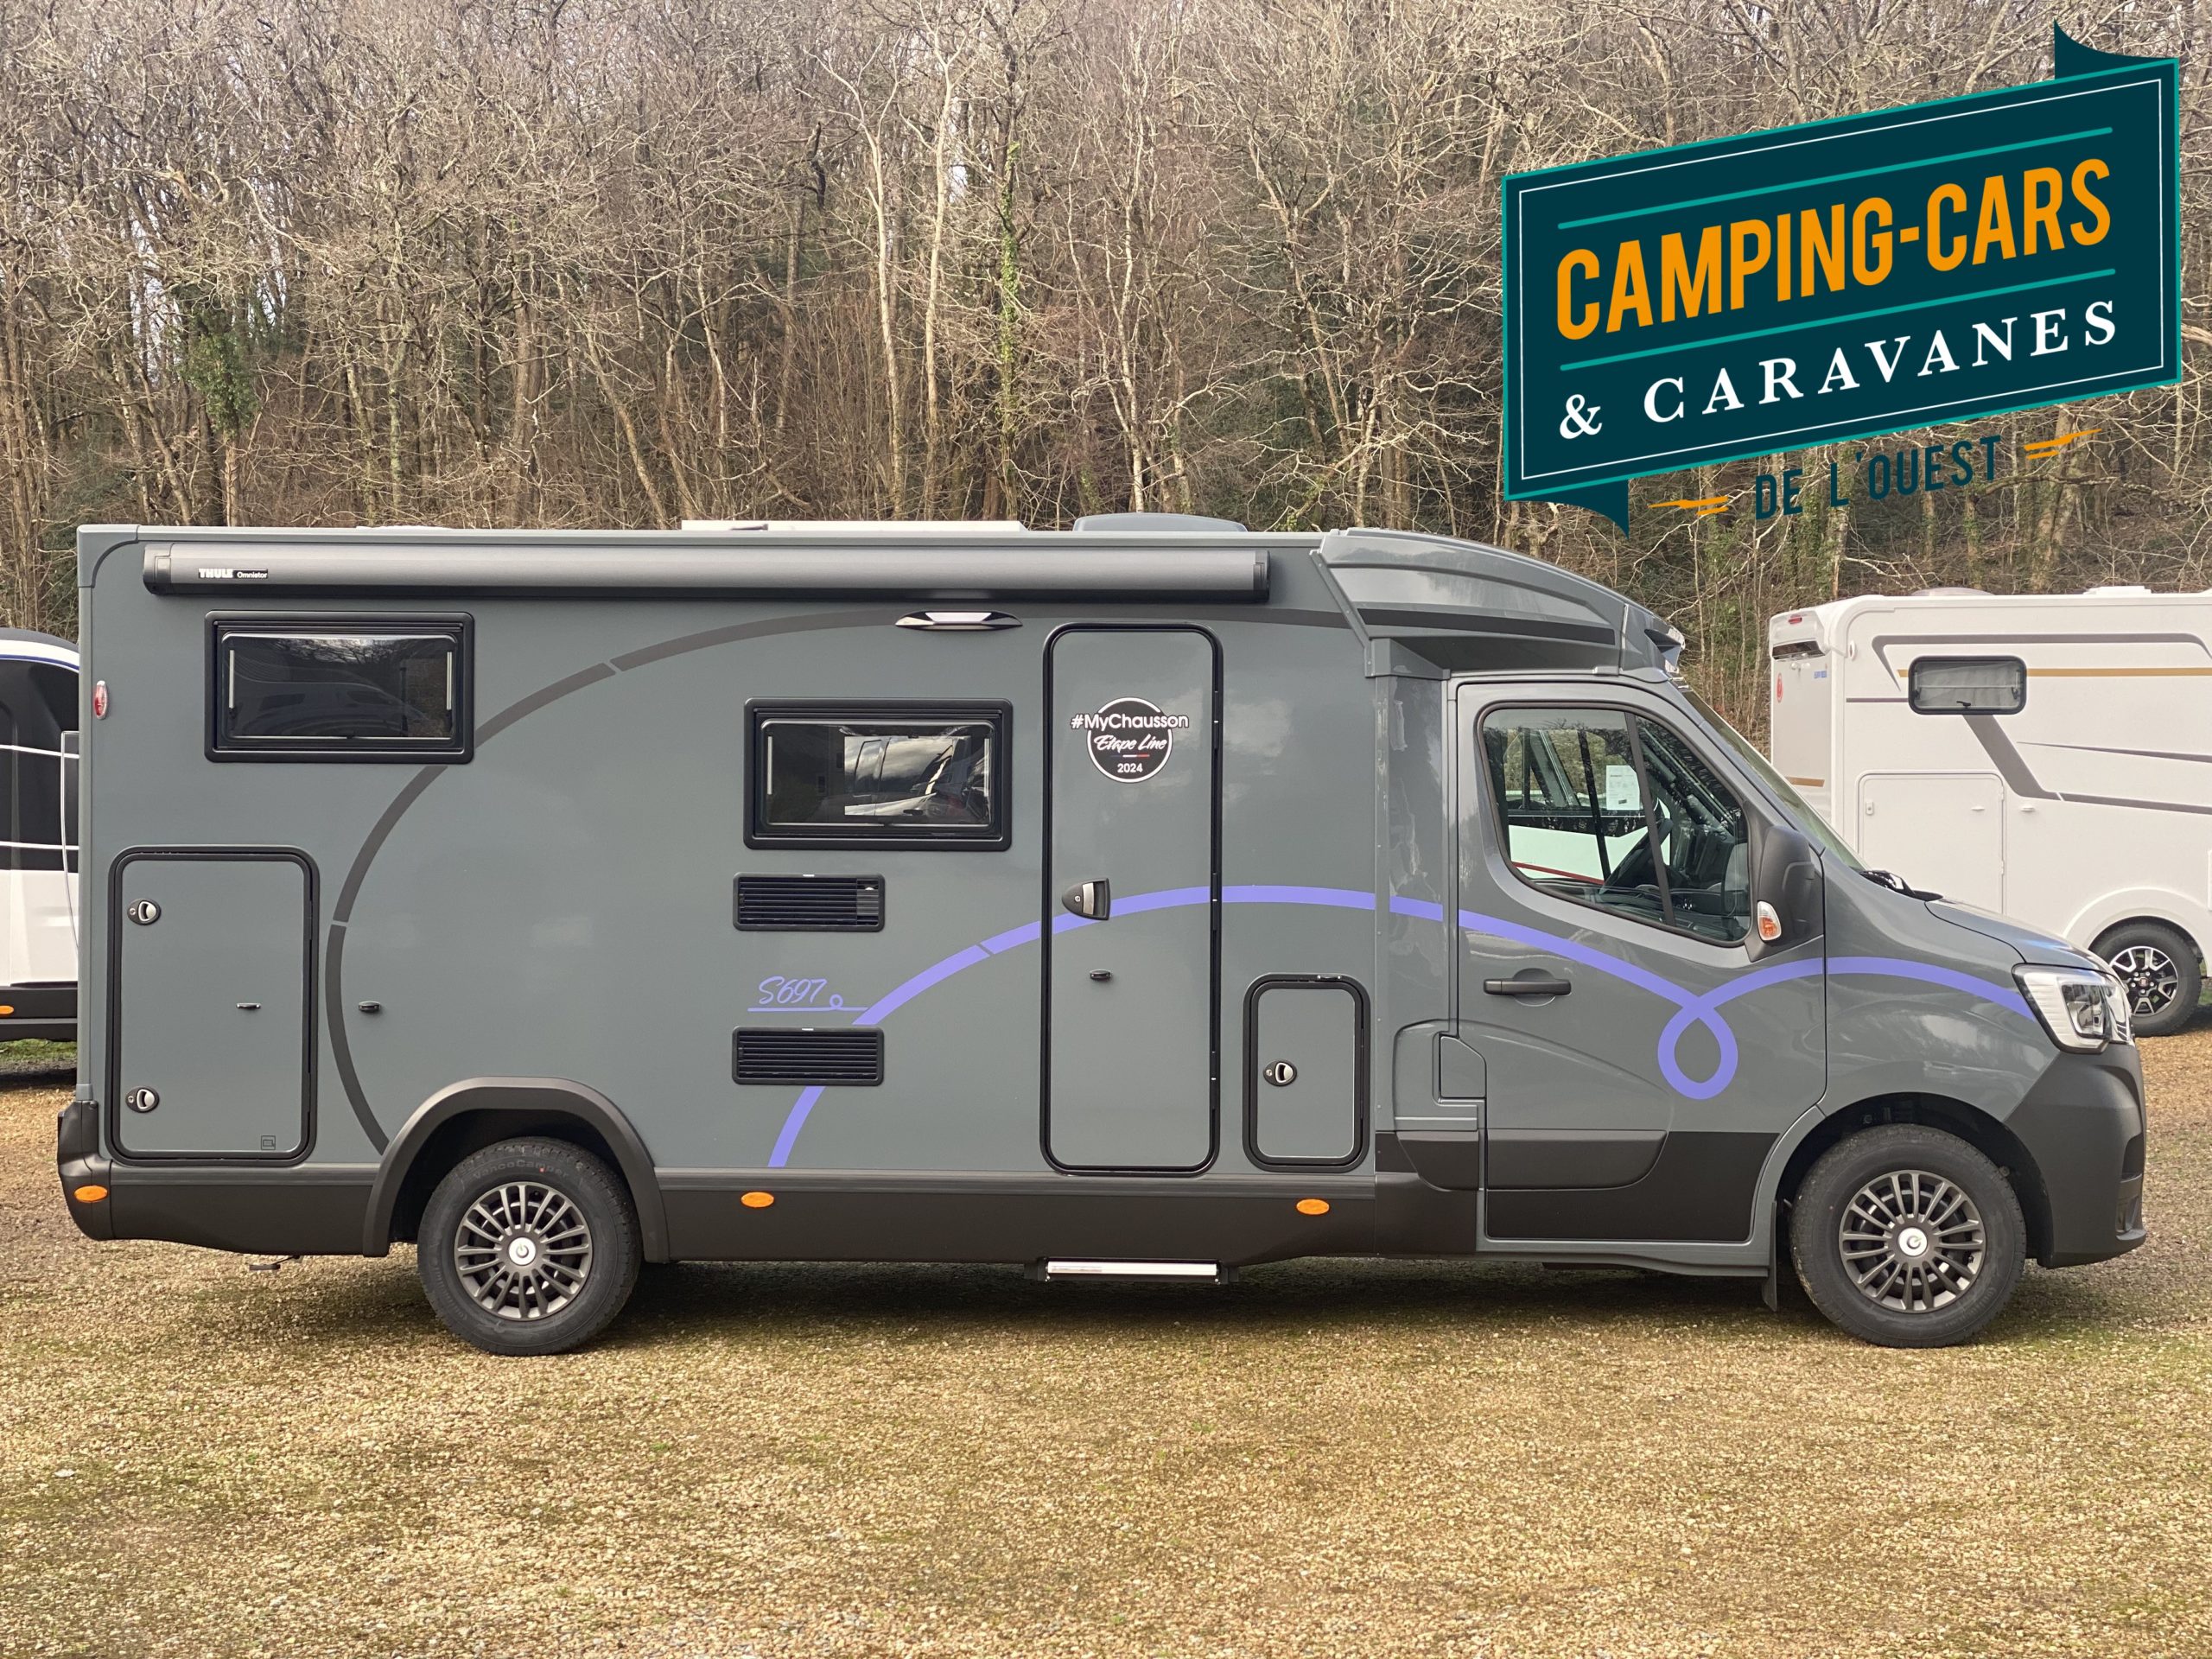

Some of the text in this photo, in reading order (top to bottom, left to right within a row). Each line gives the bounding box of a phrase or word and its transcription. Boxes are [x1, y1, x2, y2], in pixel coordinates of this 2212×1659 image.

[198, 568, 233, 579] THULE
[1071, 713, 1189, 731] #MyChausson
[1138, 734, 1167, 750] Line
[1117, 763, 1143, 773] 2024
[759, 976, 828, 1005] S697
